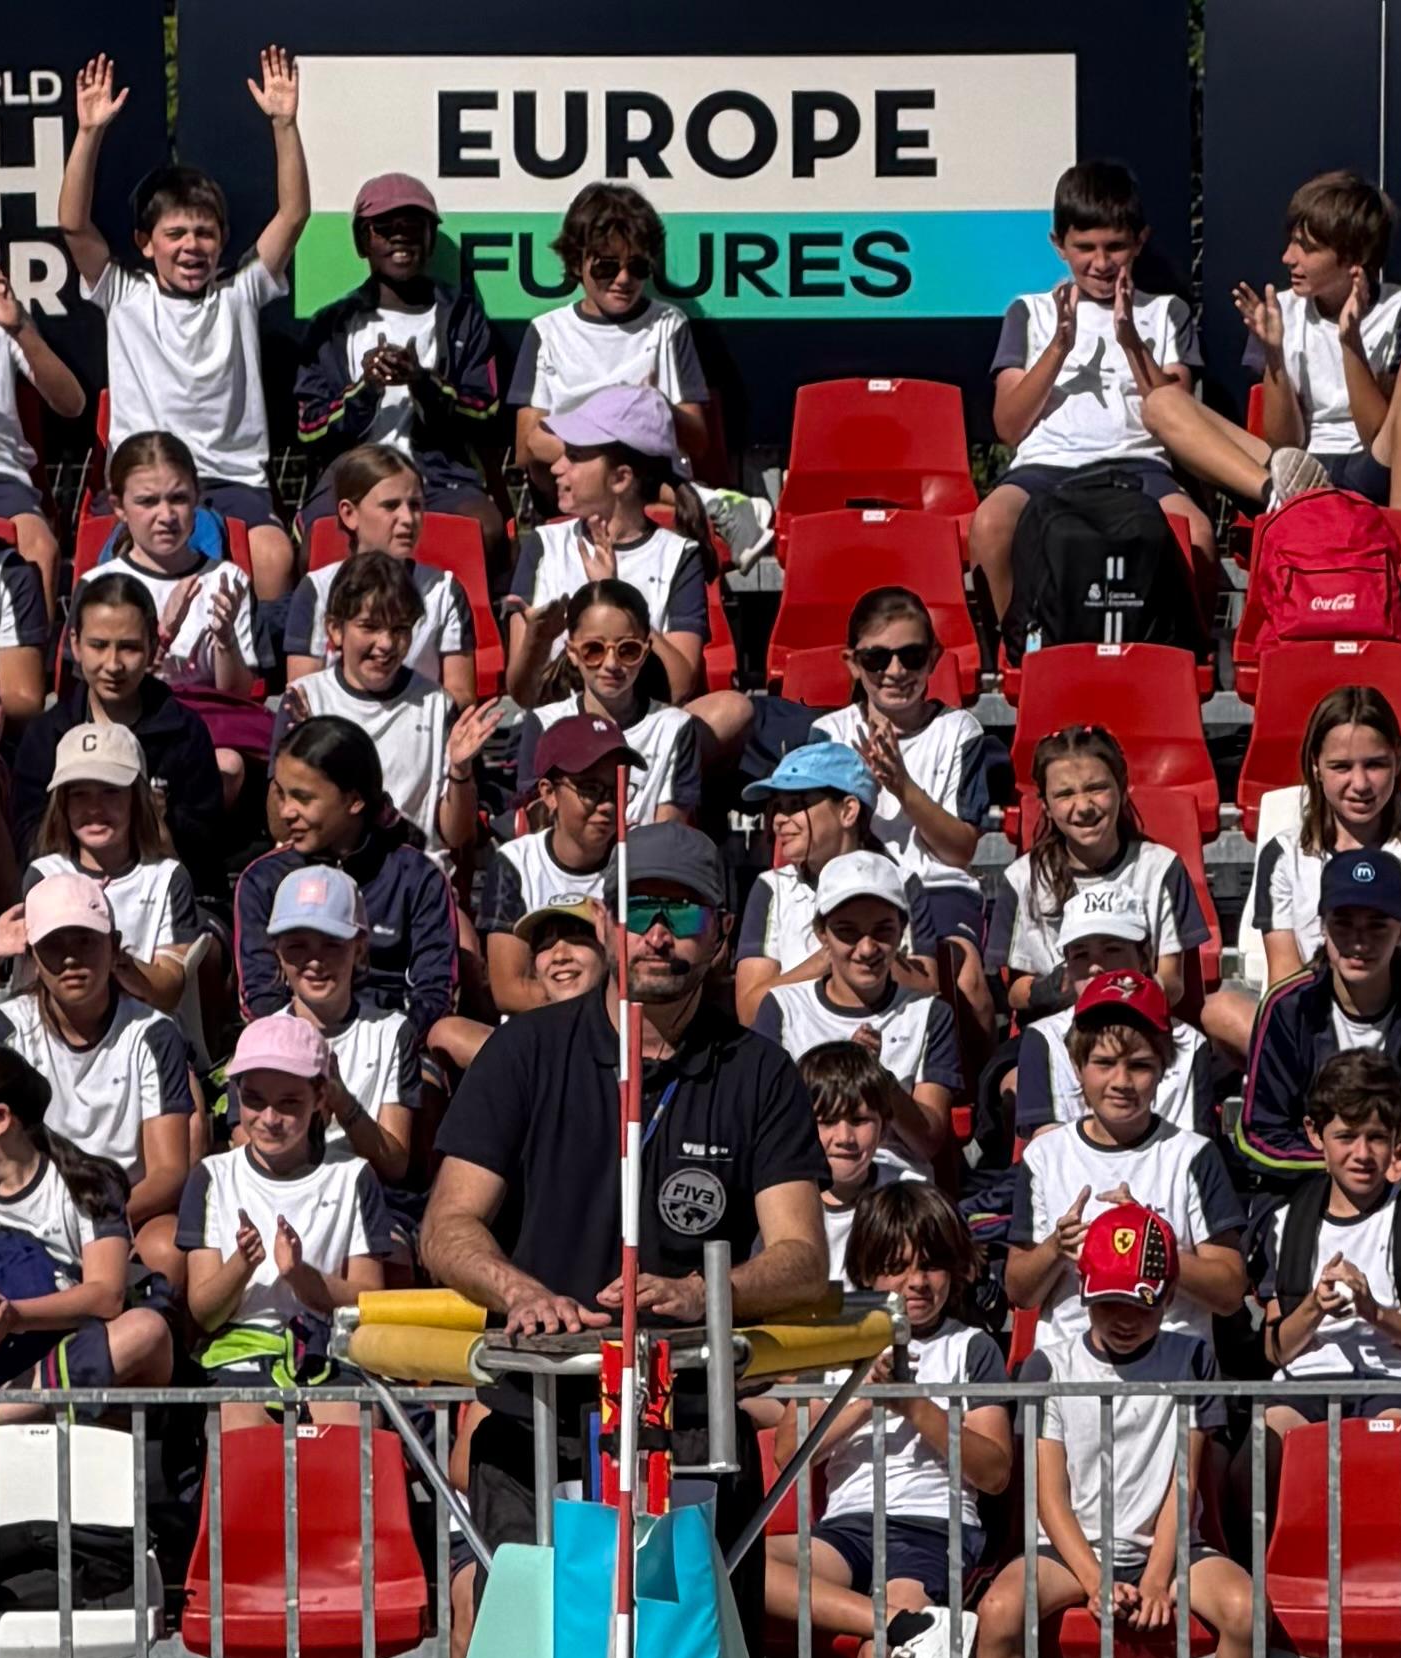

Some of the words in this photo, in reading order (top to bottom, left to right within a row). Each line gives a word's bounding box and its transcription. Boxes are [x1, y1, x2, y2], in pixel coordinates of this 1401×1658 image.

[438, 89, 938, 179] EUROPE
[460, 230, 912, 299] FUURES
[82, 734, 97, 752] C
[1084, 892, 1114, 913] M
